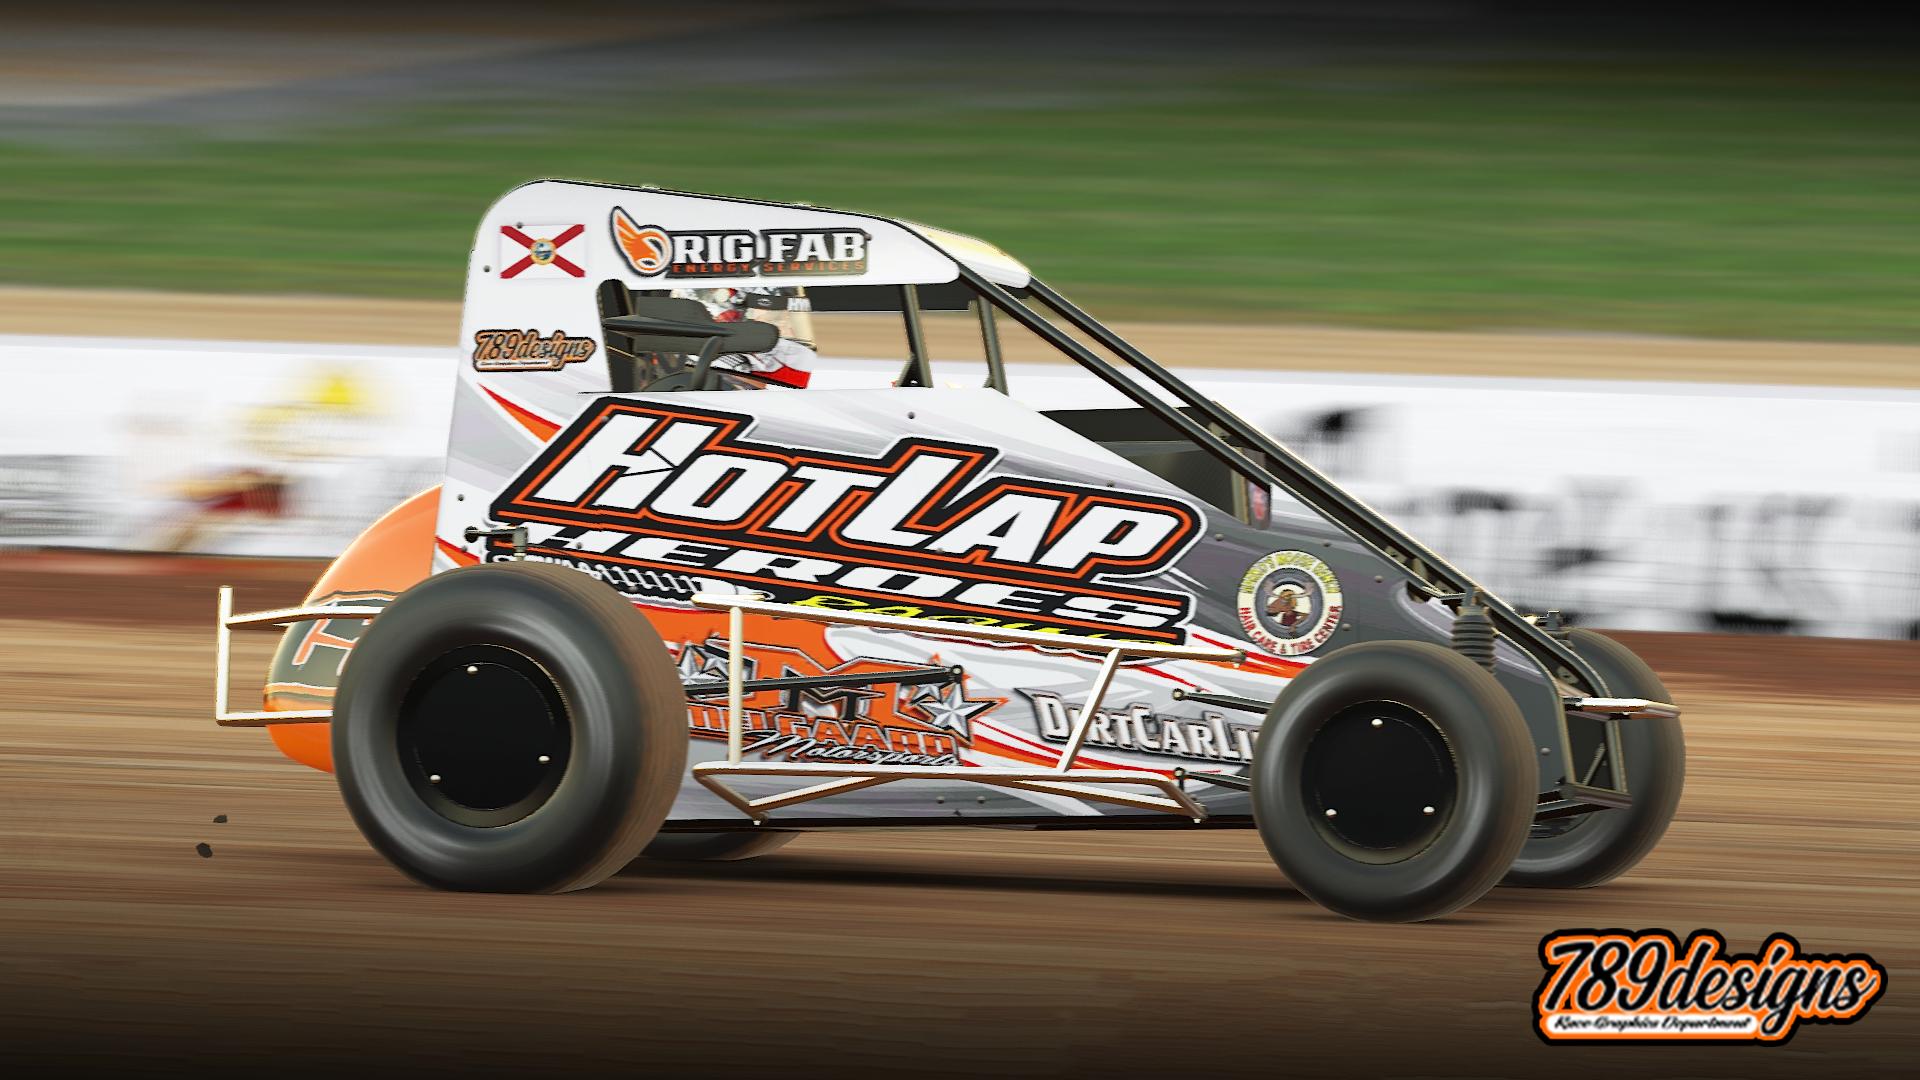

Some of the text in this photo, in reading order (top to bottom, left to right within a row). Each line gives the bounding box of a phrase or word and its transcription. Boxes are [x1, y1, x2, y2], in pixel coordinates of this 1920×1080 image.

[671, 231, 866, 264] RIG FAB
[671, 262, 751, 274] ENERGY
[514, 521, 1183, 629] HEROES
